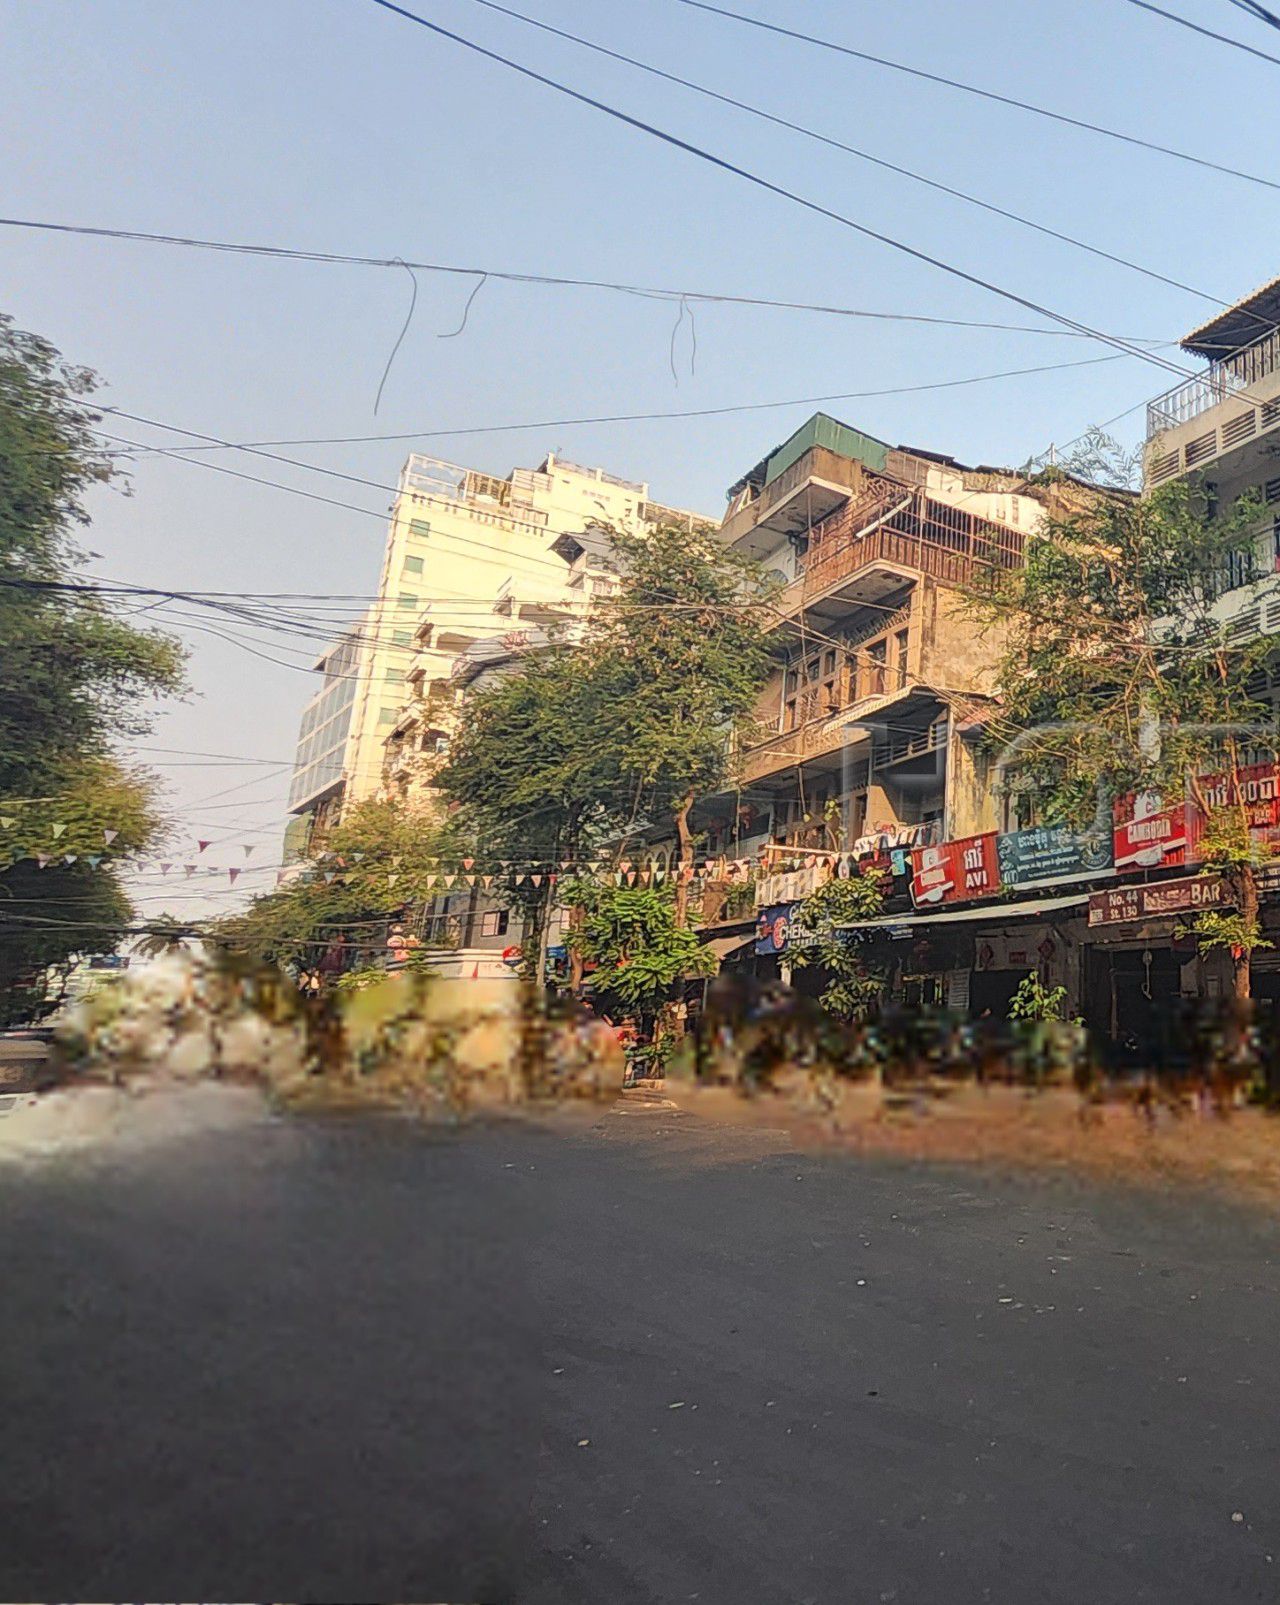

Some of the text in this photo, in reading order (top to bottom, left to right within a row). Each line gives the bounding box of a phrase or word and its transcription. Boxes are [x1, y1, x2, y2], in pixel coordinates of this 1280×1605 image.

[966, 870, 988, 888] AVI
[1109, 894, 1125, 907] No.
[1126, 890, 1139, 904] 44
[1191, 883, 1221, 904] BAR
[1122, 905, 1138, 918] 130
